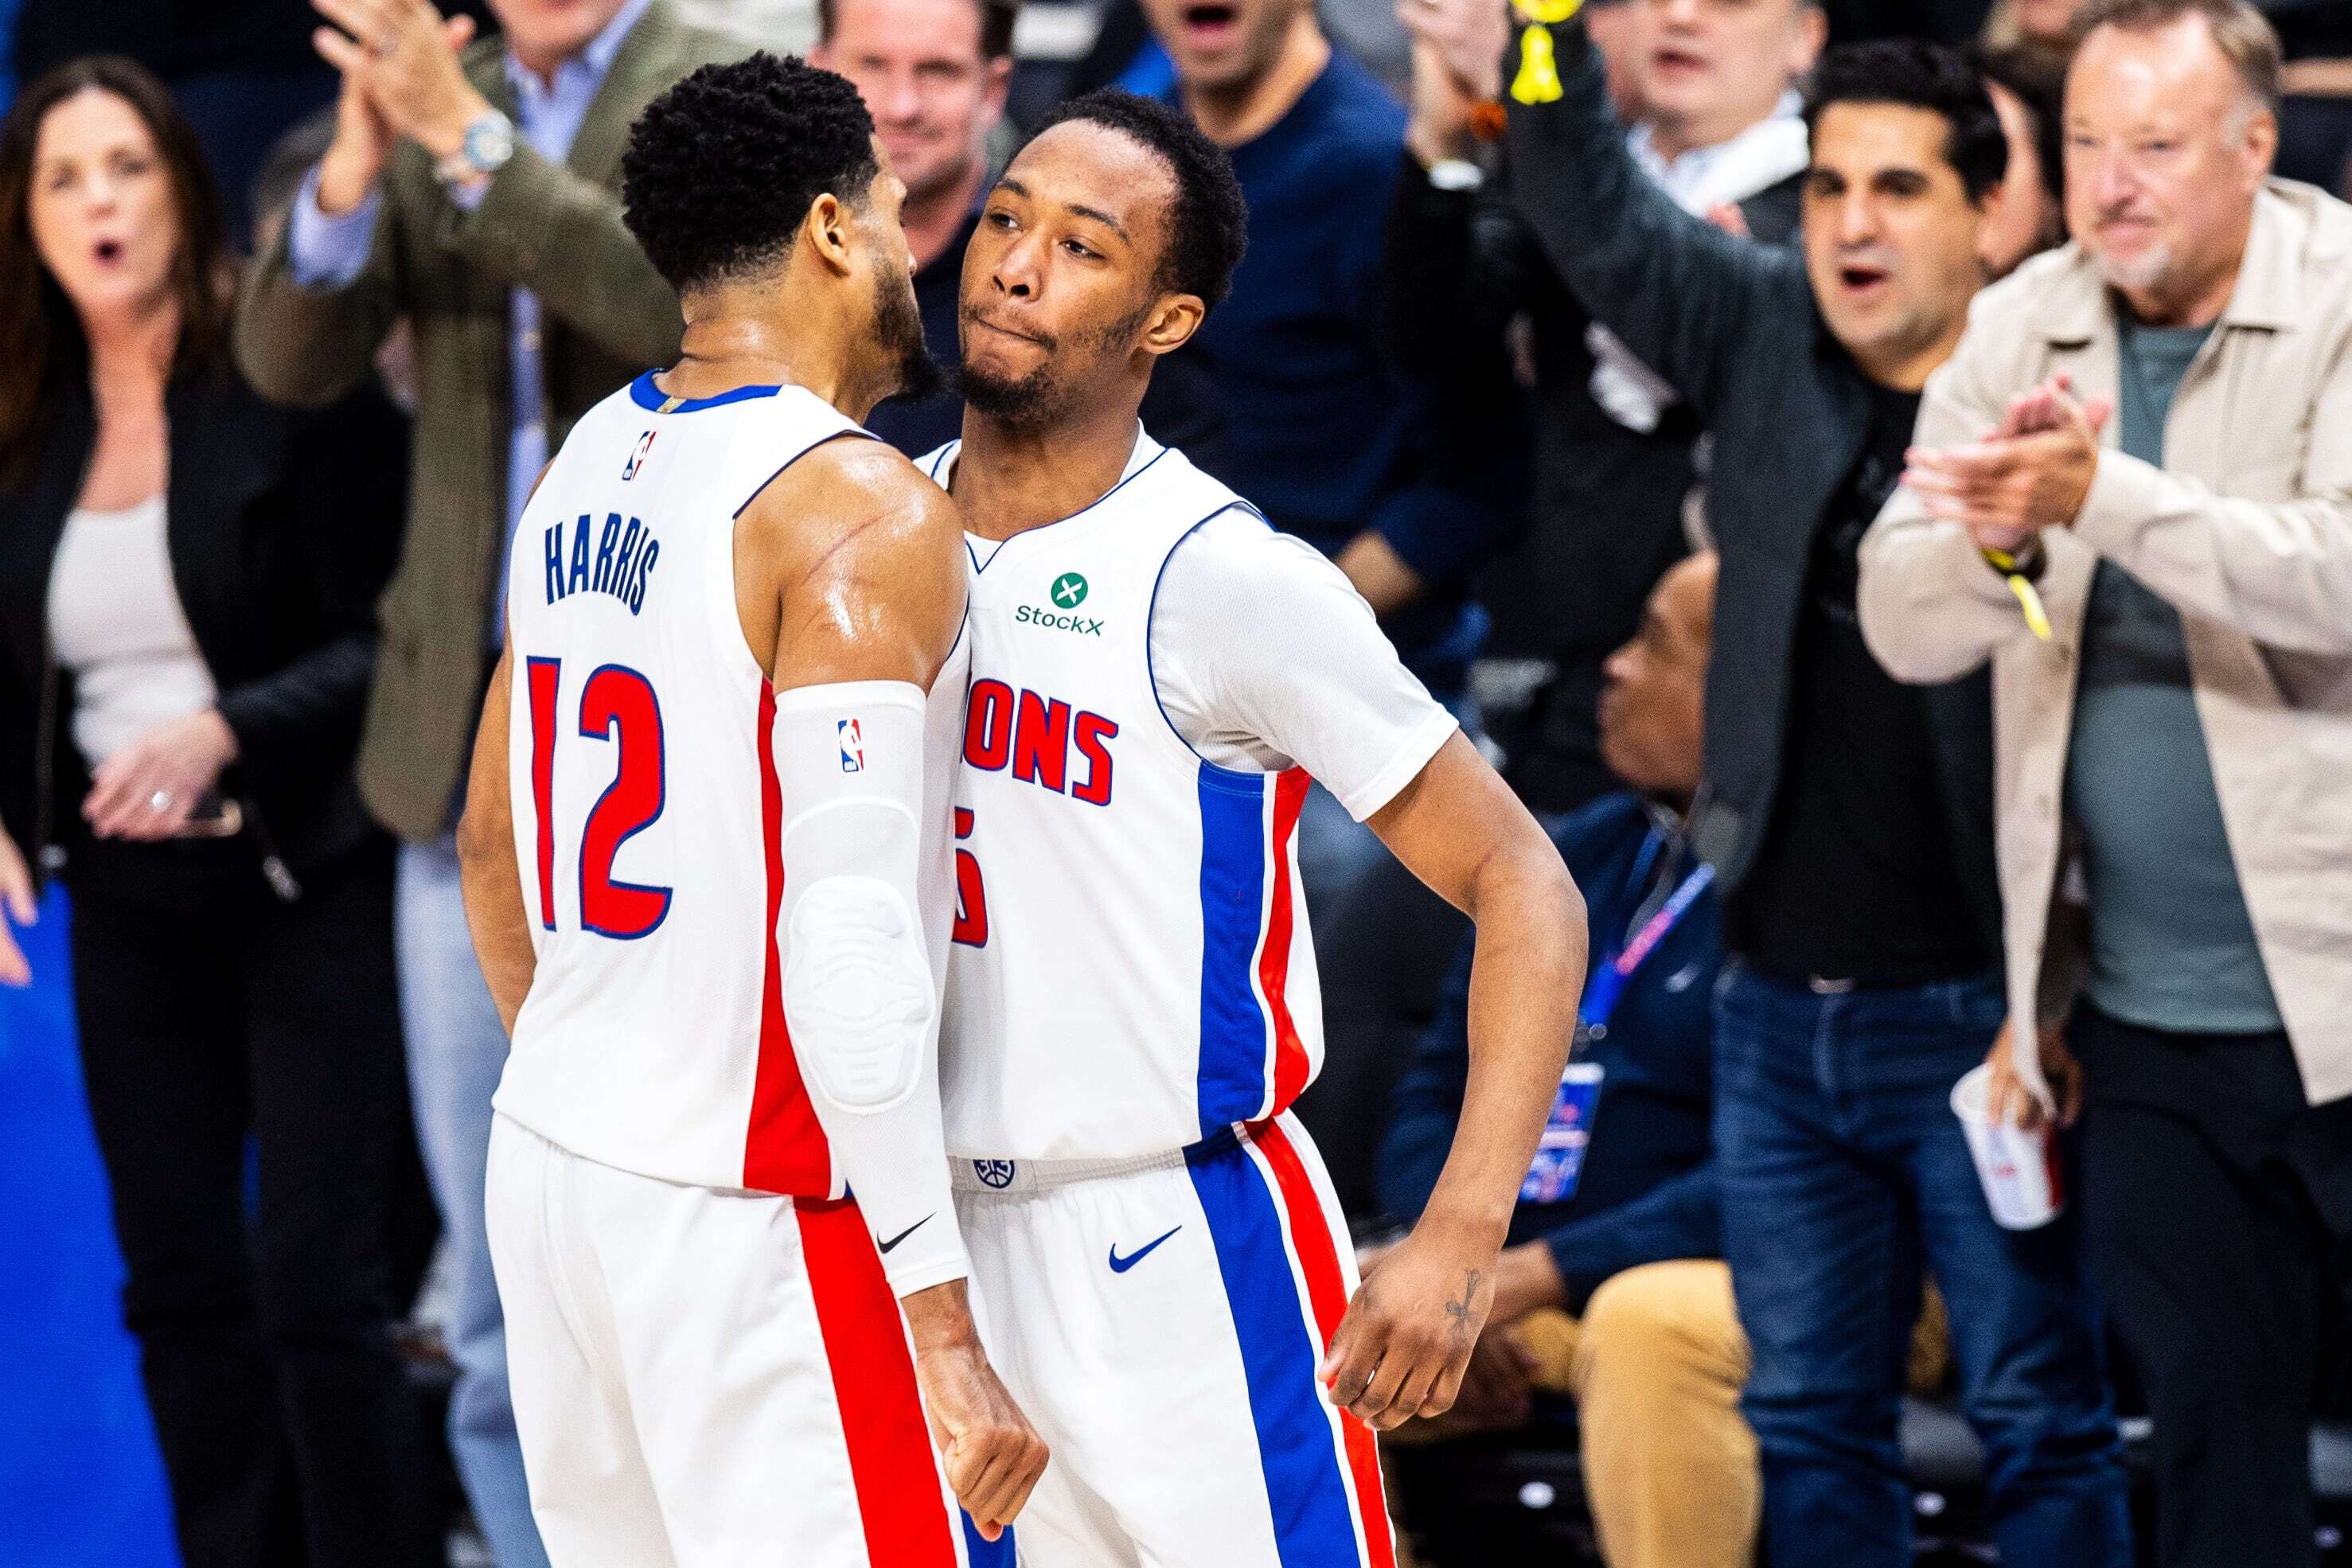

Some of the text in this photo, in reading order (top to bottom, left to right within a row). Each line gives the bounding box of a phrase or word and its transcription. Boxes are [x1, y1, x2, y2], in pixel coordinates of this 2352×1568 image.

[544, 512, 658, 617] HARRIS
[1015, 605, 1105, 637] StockX
[526, 655, 673, 940] 12
[960, 677, 1119, 807] ONS
